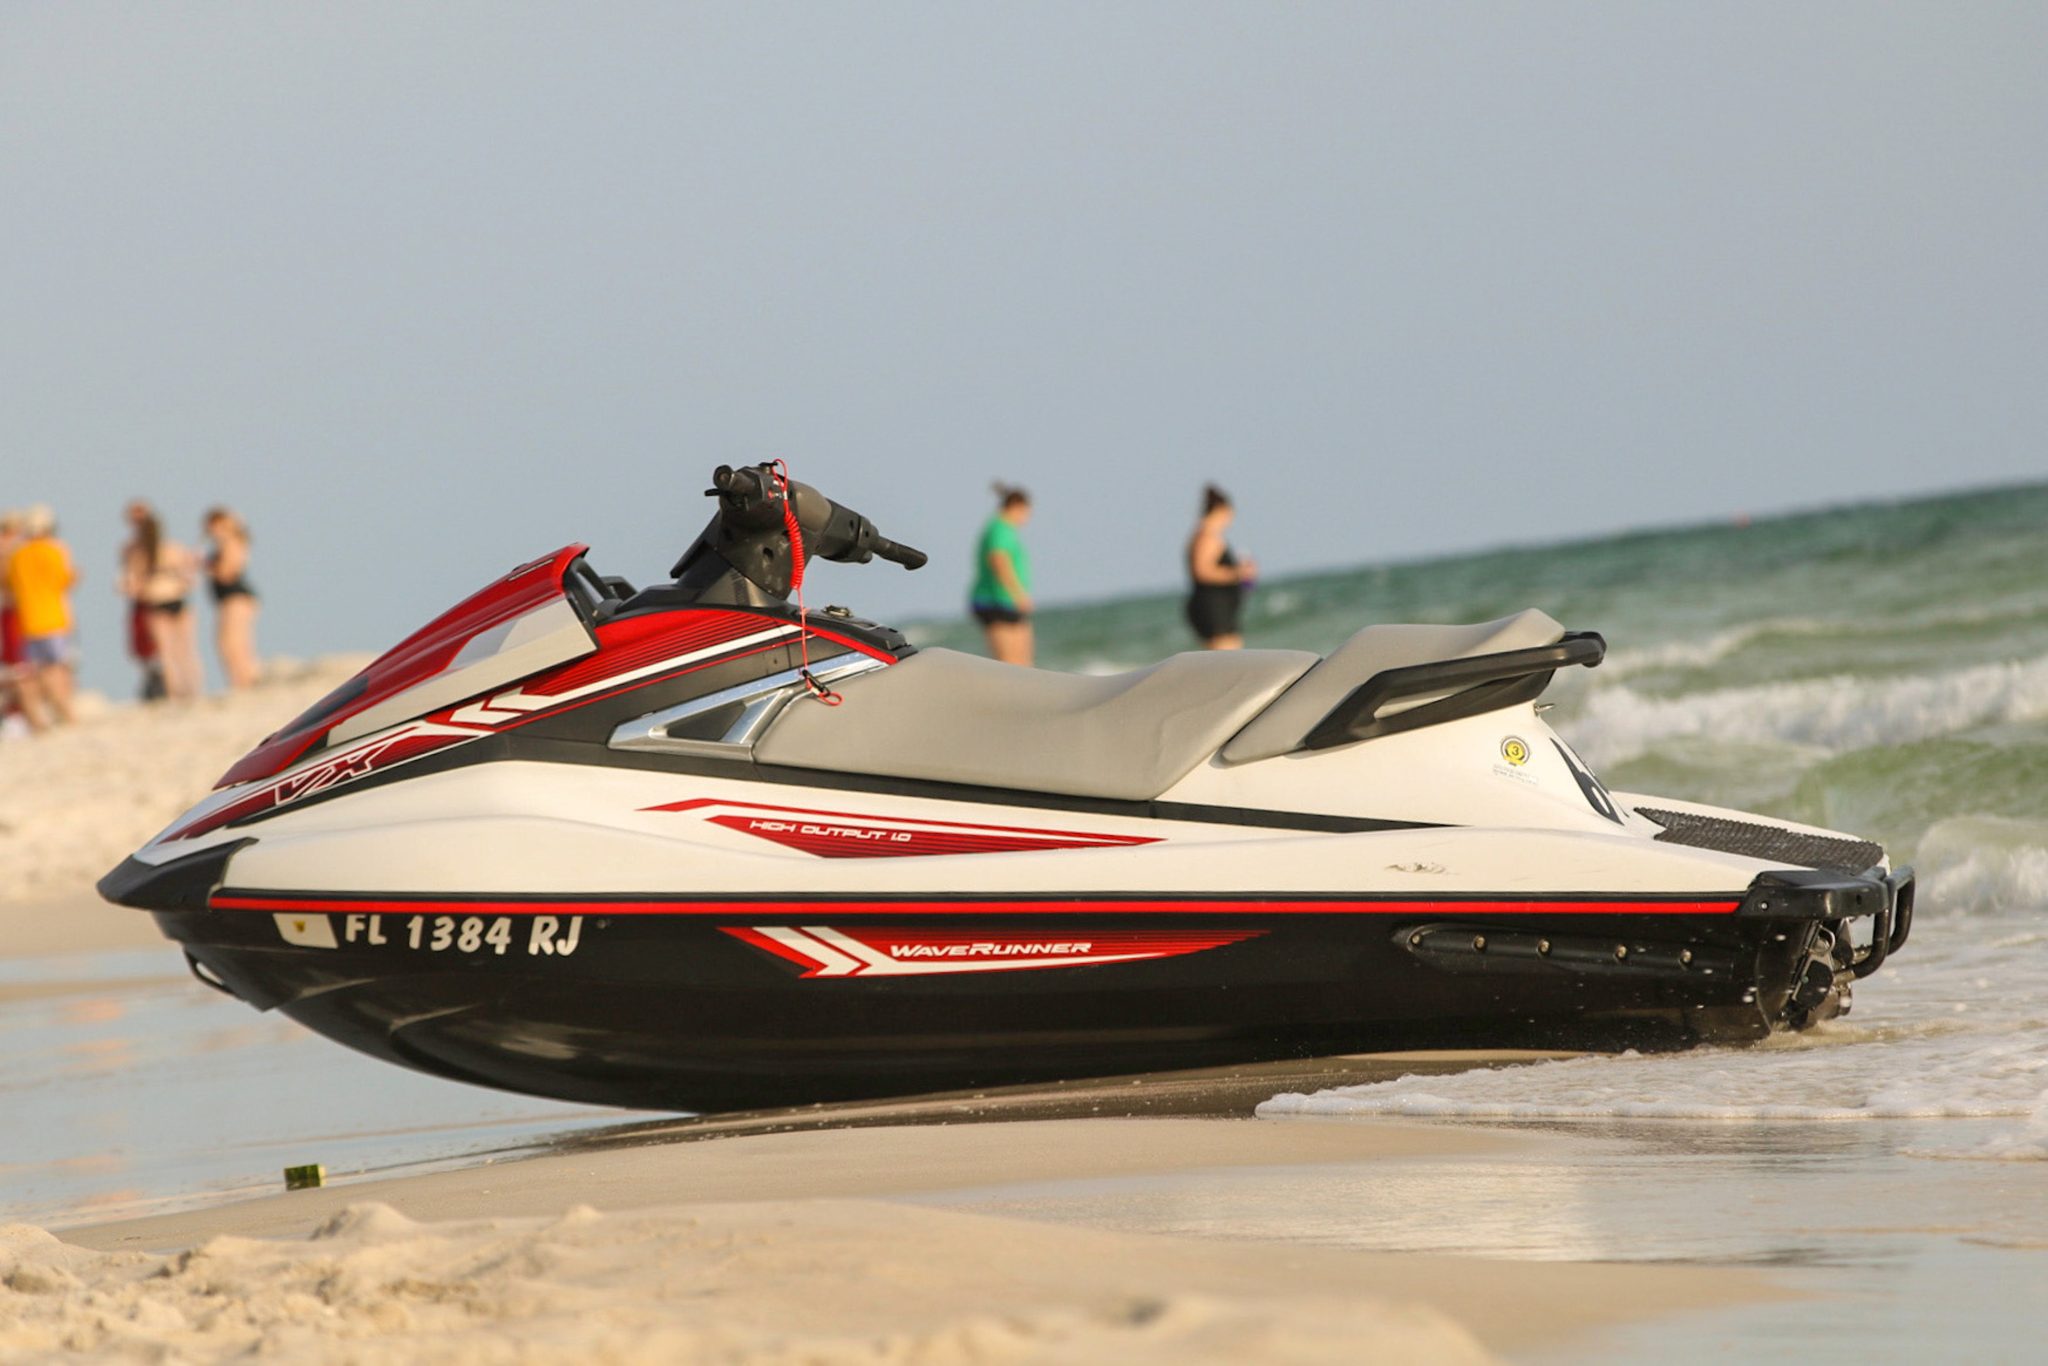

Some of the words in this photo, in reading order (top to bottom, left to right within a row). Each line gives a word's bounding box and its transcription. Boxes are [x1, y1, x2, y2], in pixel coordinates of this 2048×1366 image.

[274, 741, 393, 805] VX
[750, 820, 797, 833] HIGH
[800, 825, 887, 840] OUTPUT
[344, 914, 387, 945] FL
[406, 915, 512, 955] 1384
[527, 915, 583, 956] RJ
